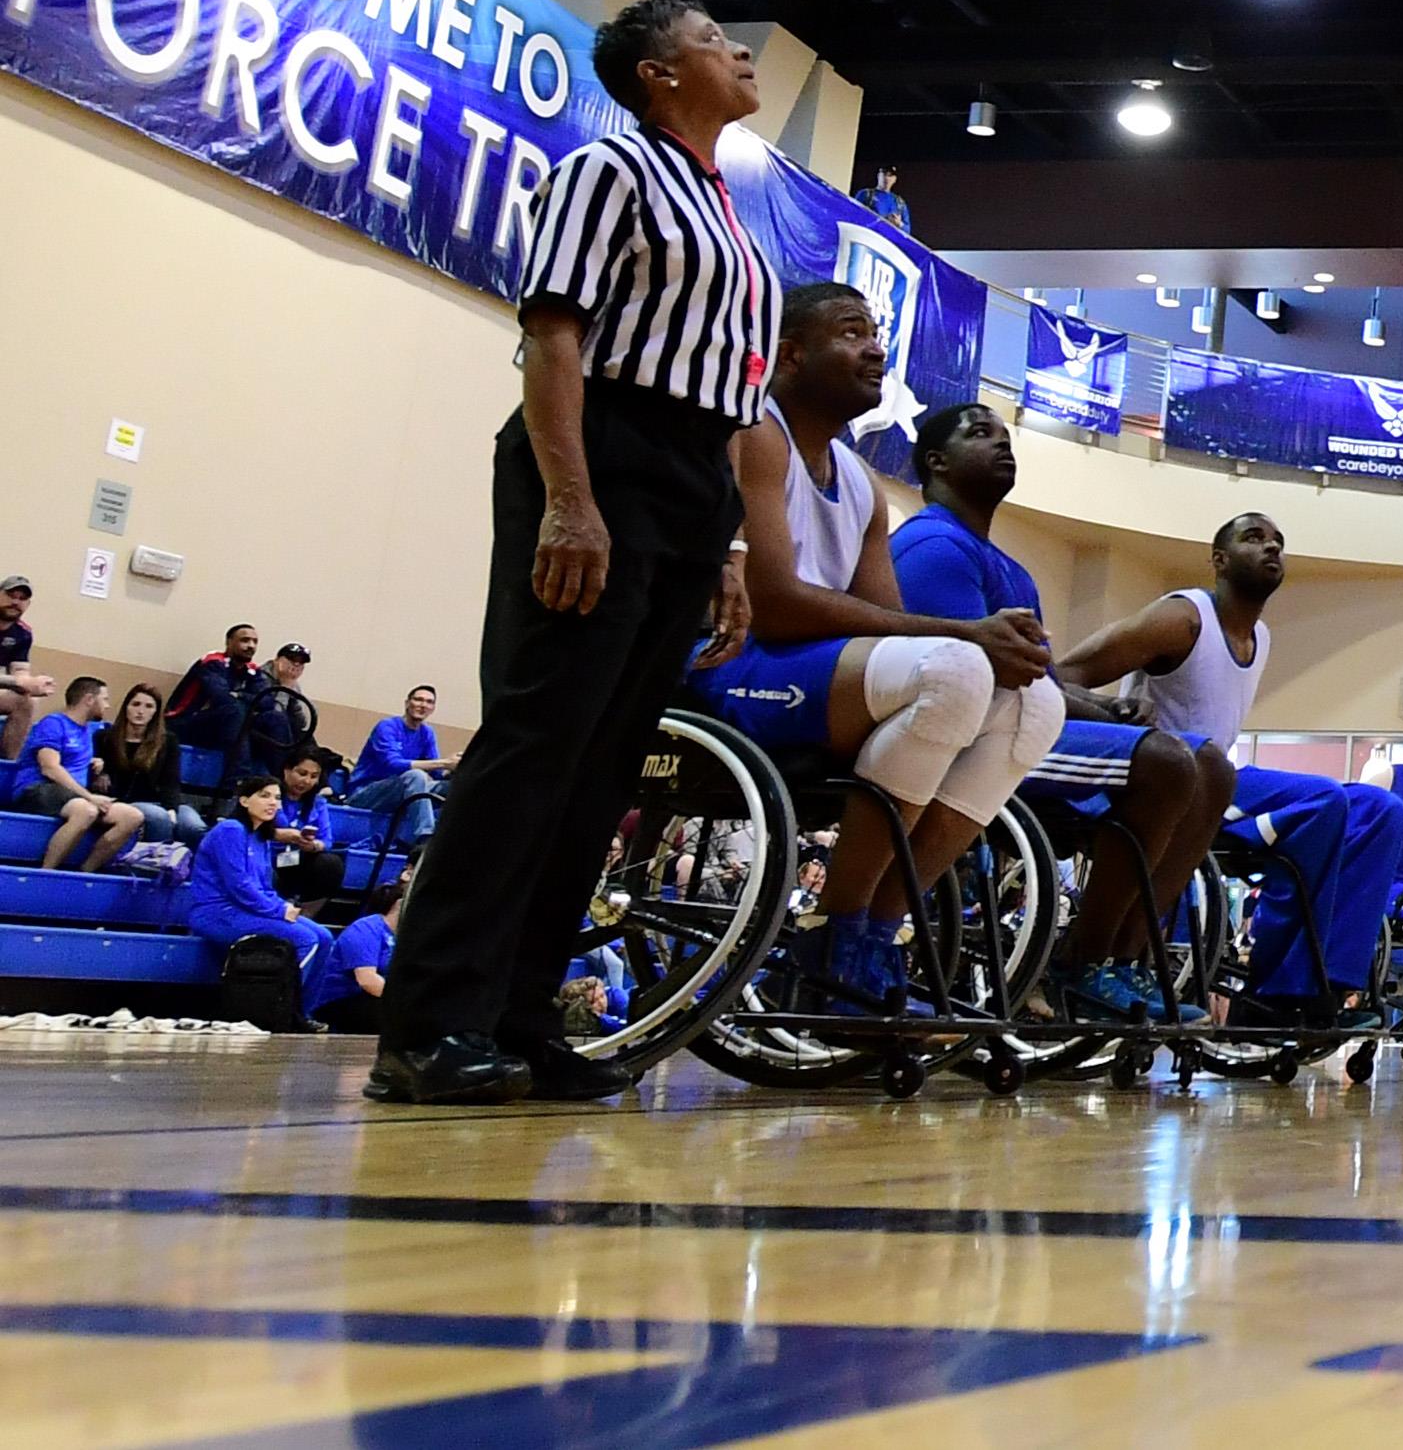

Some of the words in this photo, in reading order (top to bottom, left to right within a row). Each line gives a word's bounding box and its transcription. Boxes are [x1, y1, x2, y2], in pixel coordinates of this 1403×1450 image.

[491, 4, 569, 118] TO
[859, 254, 896, 303] AIR
[1328, 440, 1397, 458] WOUNDED
[641, 754, 682, 777] max
